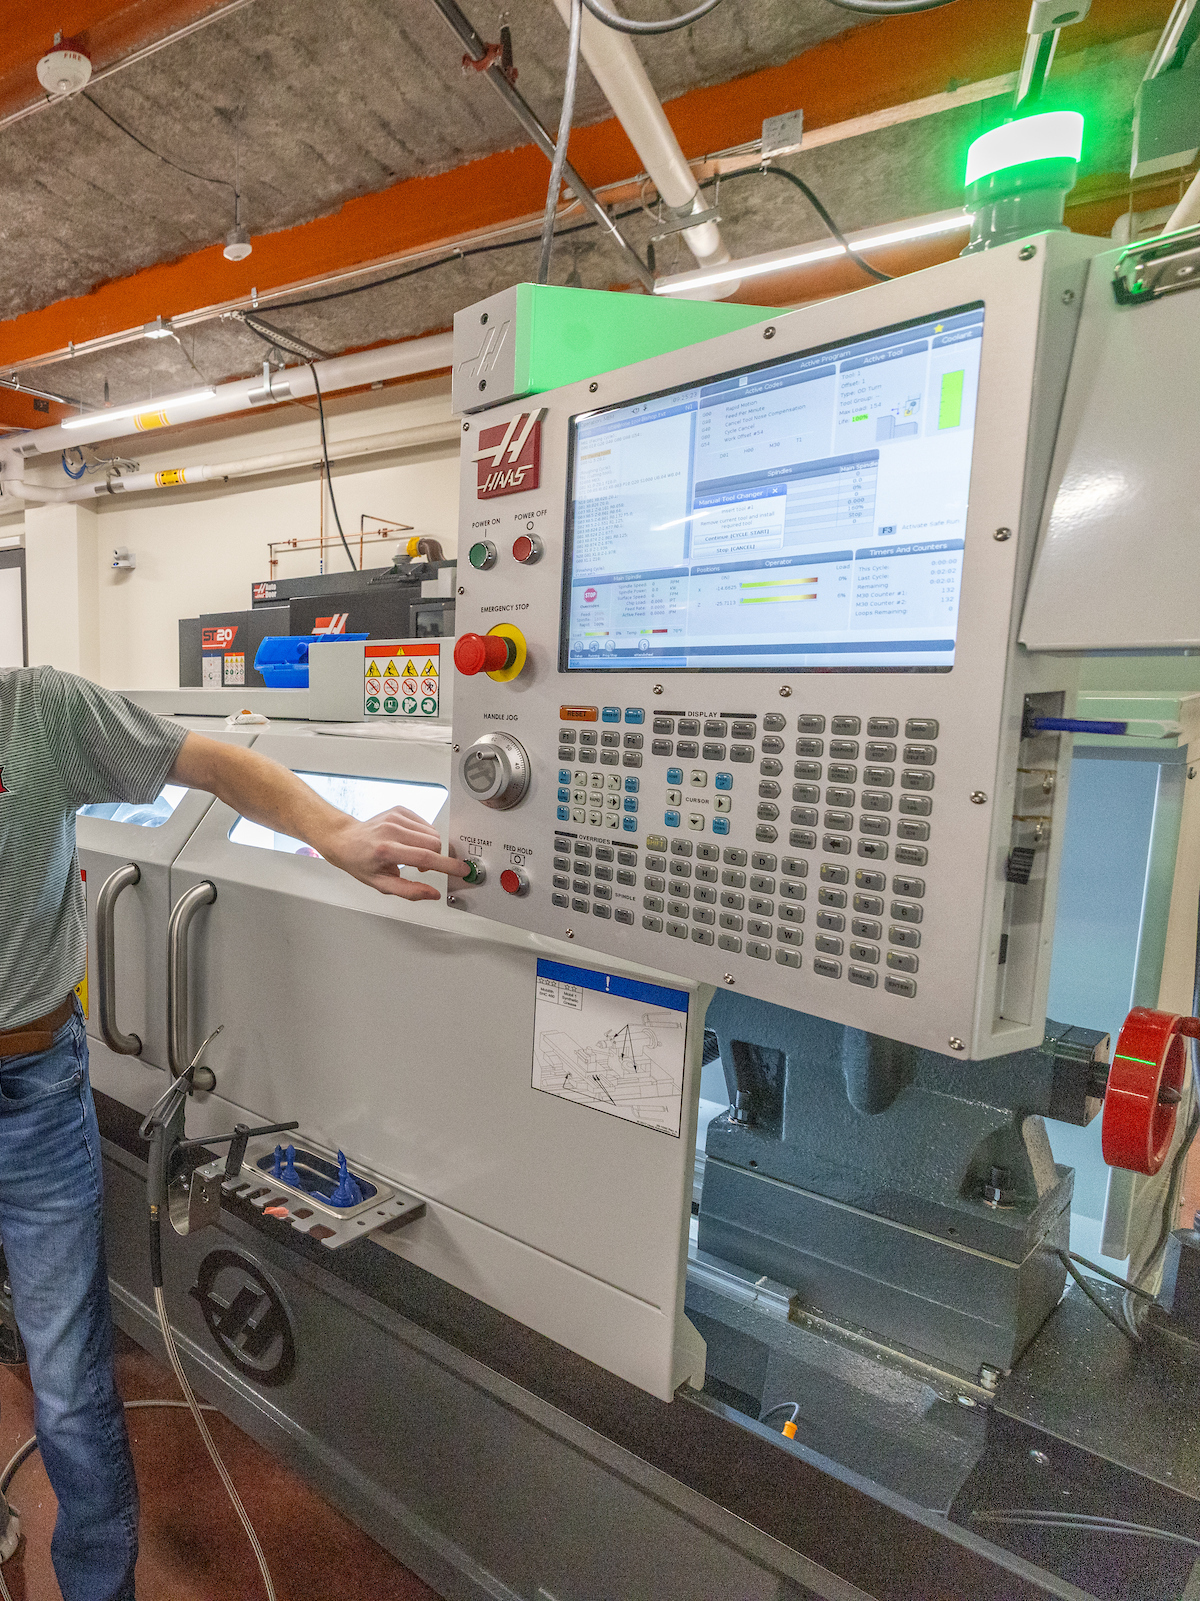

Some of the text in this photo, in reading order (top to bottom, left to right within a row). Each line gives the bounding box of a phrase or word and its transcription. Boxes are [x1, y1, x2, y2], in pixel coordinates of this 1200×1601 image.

[942, 331, 973, 344] Coolant
[800, 350, 850, 368] Active Program
[863, 349, 903, 364] Active Tool
[745, 381, 783, 395] Active Codes
[726, 400, 757, 412] Rapid Motion
[748, 406, 765, 414] Minute
[725, 404, 806, 427] Cancel Tool Nose Compensation
[852, 414, 868, 422] 100%
[738, 424, 755, 432] Cancel
[840, 461, 878, 473] Main Spindle
[768, 468, 792, 477] Spindles
[478, 464, 534, 493] HAAS
[699, 490, 763, 506] Manual Tool Changer
[514, 510, 547, 521] POWER OFF
[472, 520, 490, 528] POWER
[870, 548, 894, 556] Timers
[913, 543, 947, 551] Counters
[765, 559, 792, 567] Operator
[481, 605, 515, 613] EMERGENCY
[460, 836, 492, 847] CYCLE START
[579, 835, 611, 845] OVERRIDES
[647, 838, 664, 847] SHIFT
[504, 844, 533, 855] FEED HOLD
[615, 893, 636, 901] SPINDLE
[815, 963, 836, 972] CANCEL
[852, 973, 871, 981] SPACE
[889, 982, 909, 990] ENTER
